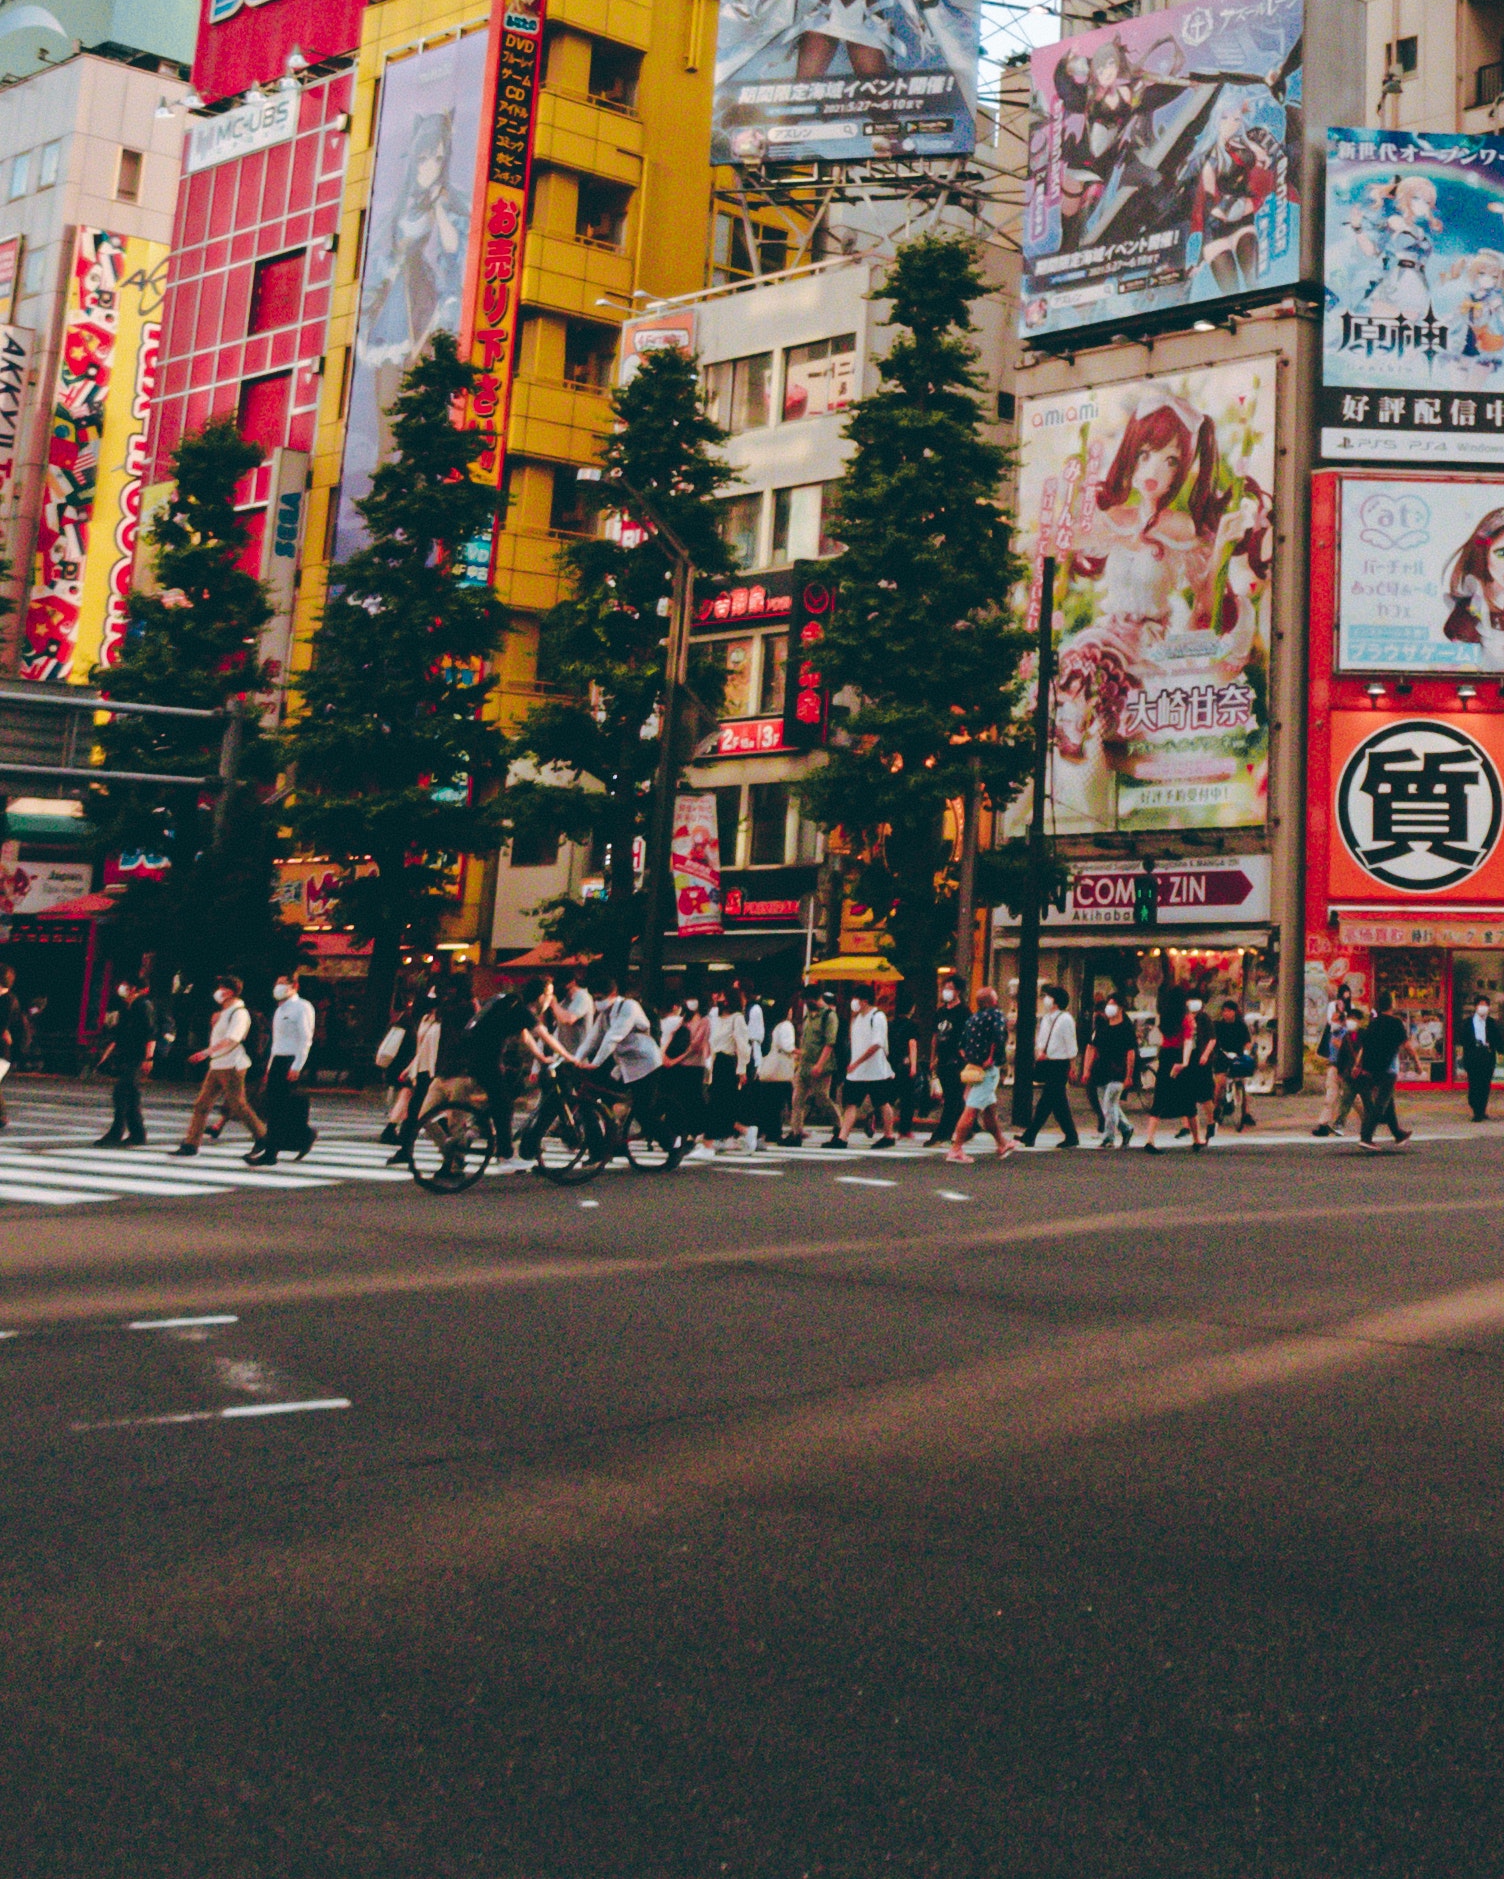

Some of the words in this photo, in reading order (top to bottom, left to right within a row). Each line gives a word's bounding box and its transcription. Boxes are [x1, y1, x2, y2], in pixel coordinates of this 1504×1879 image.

[505, 34, 535, 53] DVD
[502, 69, 531, 87] ゲーム
[505, 85, 526, 101] CD
[498, 100, 529, 118] アイドル
[497, 116, 528, 135] アニメ
[496, 135, 525, 151] コミック
[1337, 298, 1449, 378] 原神
[1032, 402, 1099, 428] amiami
[1457, 441, 1504, 454] Windows
[1350, 643, 1480, 662] ブラウザゲーム!
[1127, 683, 1250, 735] 大崎甘奈
[721, 729, 739, 751] 2F
[762, 726, 779, 748] 3F
[1361, 748, 1482, 868] 質
[1169, 876, 1206, 903] ZIN
